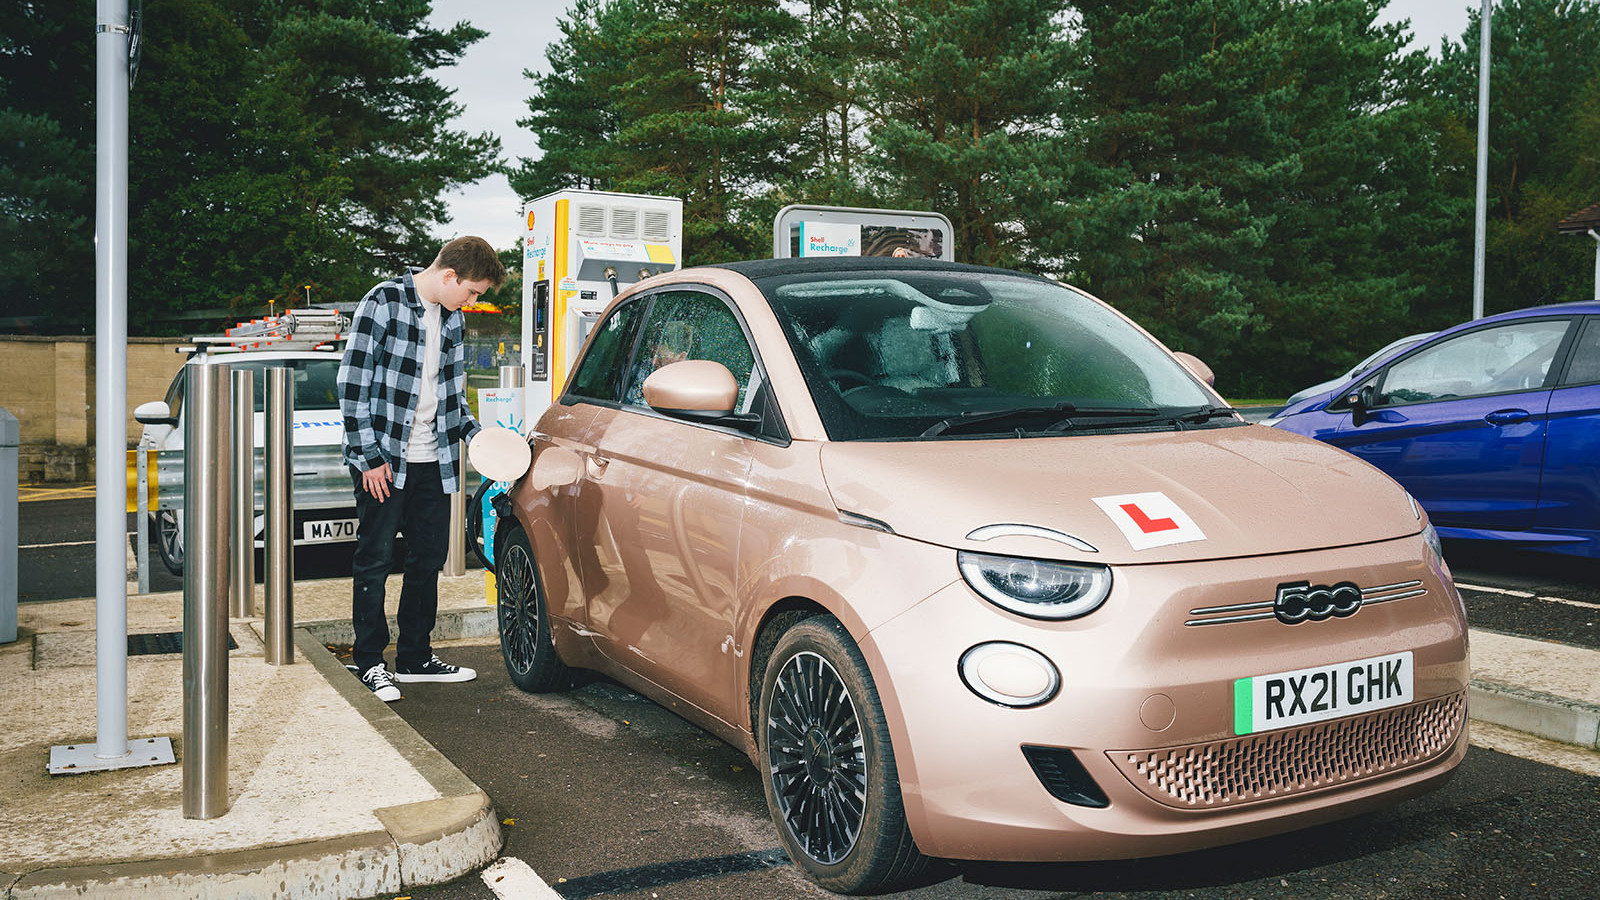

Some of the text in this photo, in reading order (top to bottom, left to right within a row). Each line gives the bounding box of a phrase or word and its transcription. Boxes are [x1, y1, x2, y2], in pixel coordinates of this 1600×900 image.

[527, 247, 546, 259] Recharge
[810, 243, 848, 254] Recharge
[311, 521, 354, 538] MA70
[1119, 503, 1179, 534] L
[1275, 580, 1362, 625] 500
[1266, 659, 1403, 720] RX21 GHK
